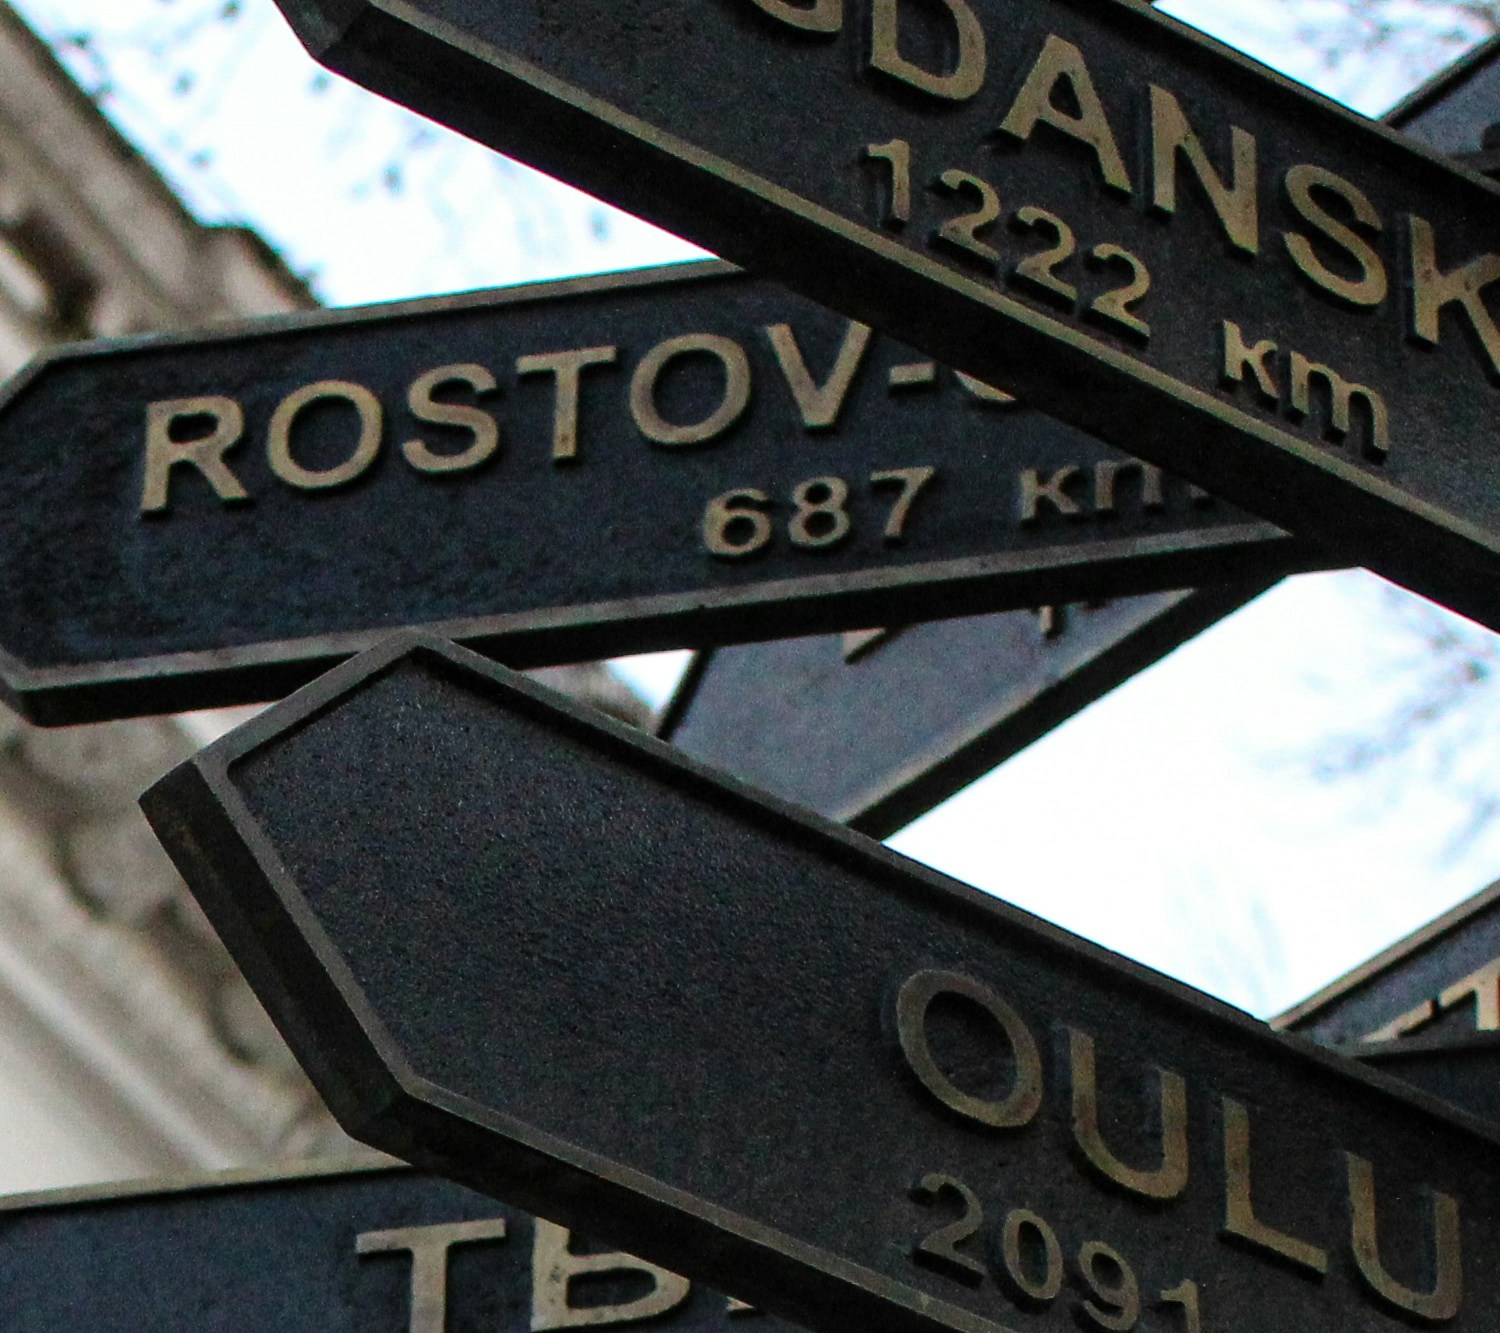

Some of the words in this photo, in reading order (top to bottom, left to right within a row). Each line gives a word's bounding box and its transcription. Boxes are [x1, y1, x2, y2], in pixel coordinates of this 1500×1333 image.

[141, 322, 1017, 512] ROSTOV-
[867, 138, 1151, 338] 1222
[1223, 320, 1389, 452] km
[703, 466, 935, 556] 687
[896, 969, 1462, 1320] OULU
